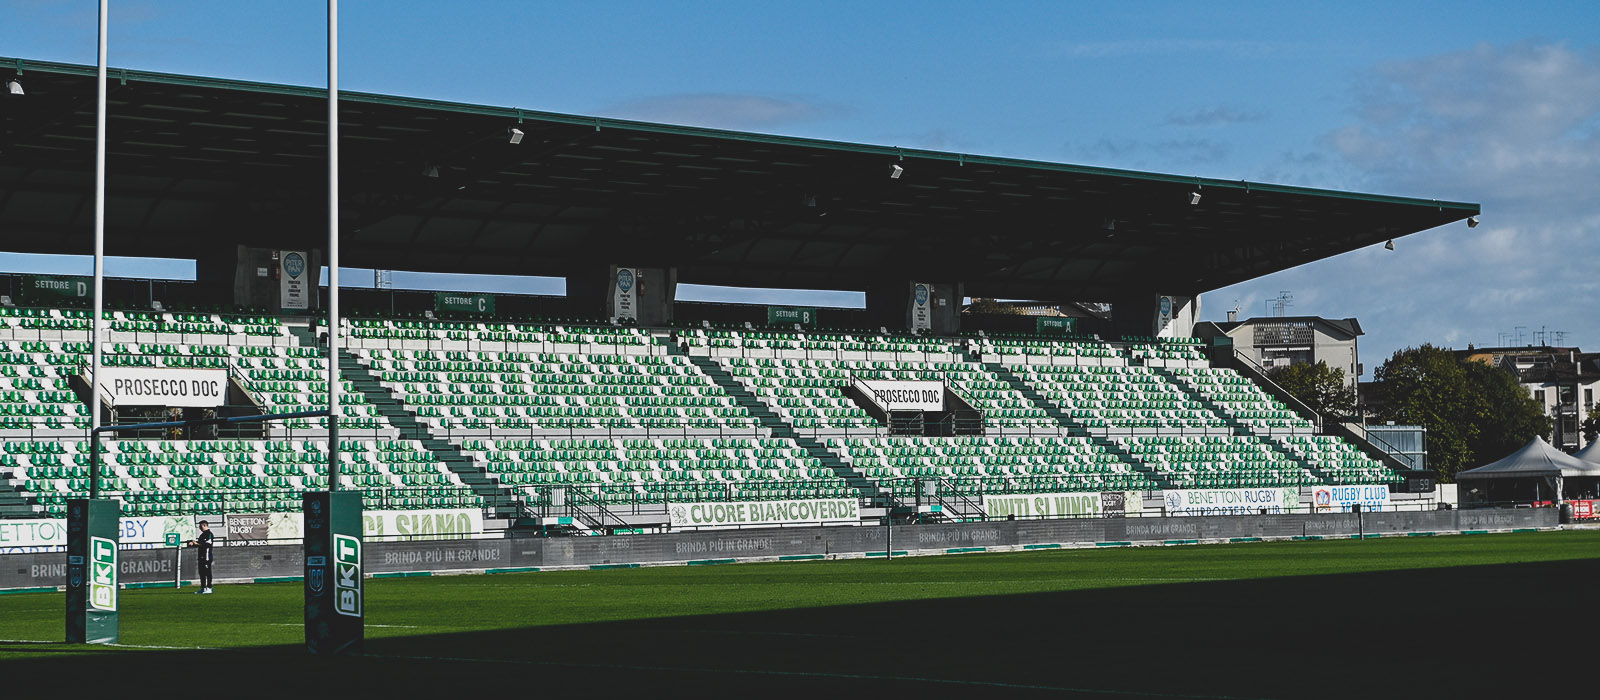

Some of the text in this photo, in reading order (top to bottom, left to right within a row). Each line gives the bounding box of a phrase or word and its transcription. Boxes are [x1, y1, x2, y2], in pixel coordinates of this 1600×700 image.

[35, 281, 87, 297] SETTORE D
[444, 297, 486, 312] SETTORE C
[776, 310, 810, 324] SETTORE B
[1065, 321, 1072, 333] A
[115, 379, 219, 397] PROSECCO DOC
[874, 389, 940, 403] PROSECCO DOC
[1188, 490, 1276, 504] BENETTON RUGBY
[1332, 487, 1386, 501] RUGBY CLUB
[691, 501, 856, 524] CUORE BIANCOVERDE
[1034, 497, 1050, 520] SI
[1055, 495, 1099, 519] VINCE
[229, 518, 265, 526] BENETTON
[396, 513, 472, 542] SIAMO
[230, 526, 254, 534] RUGBY
[919, 529, 1001, 542] BRINDA PIÙ IN GRANDE!
[676, 538, 772, 553] BRINDA PIÙ IN GRANDE!
[385, 547, 500, 564] BRINDA PIÙ IN GRANDE!
[31, 563, 67, 578] BRIND
[120, 560, 172, 574] GRANDE!
[95, 541, 112, 607] BKT
[339, 539, 355, 612] BKT
